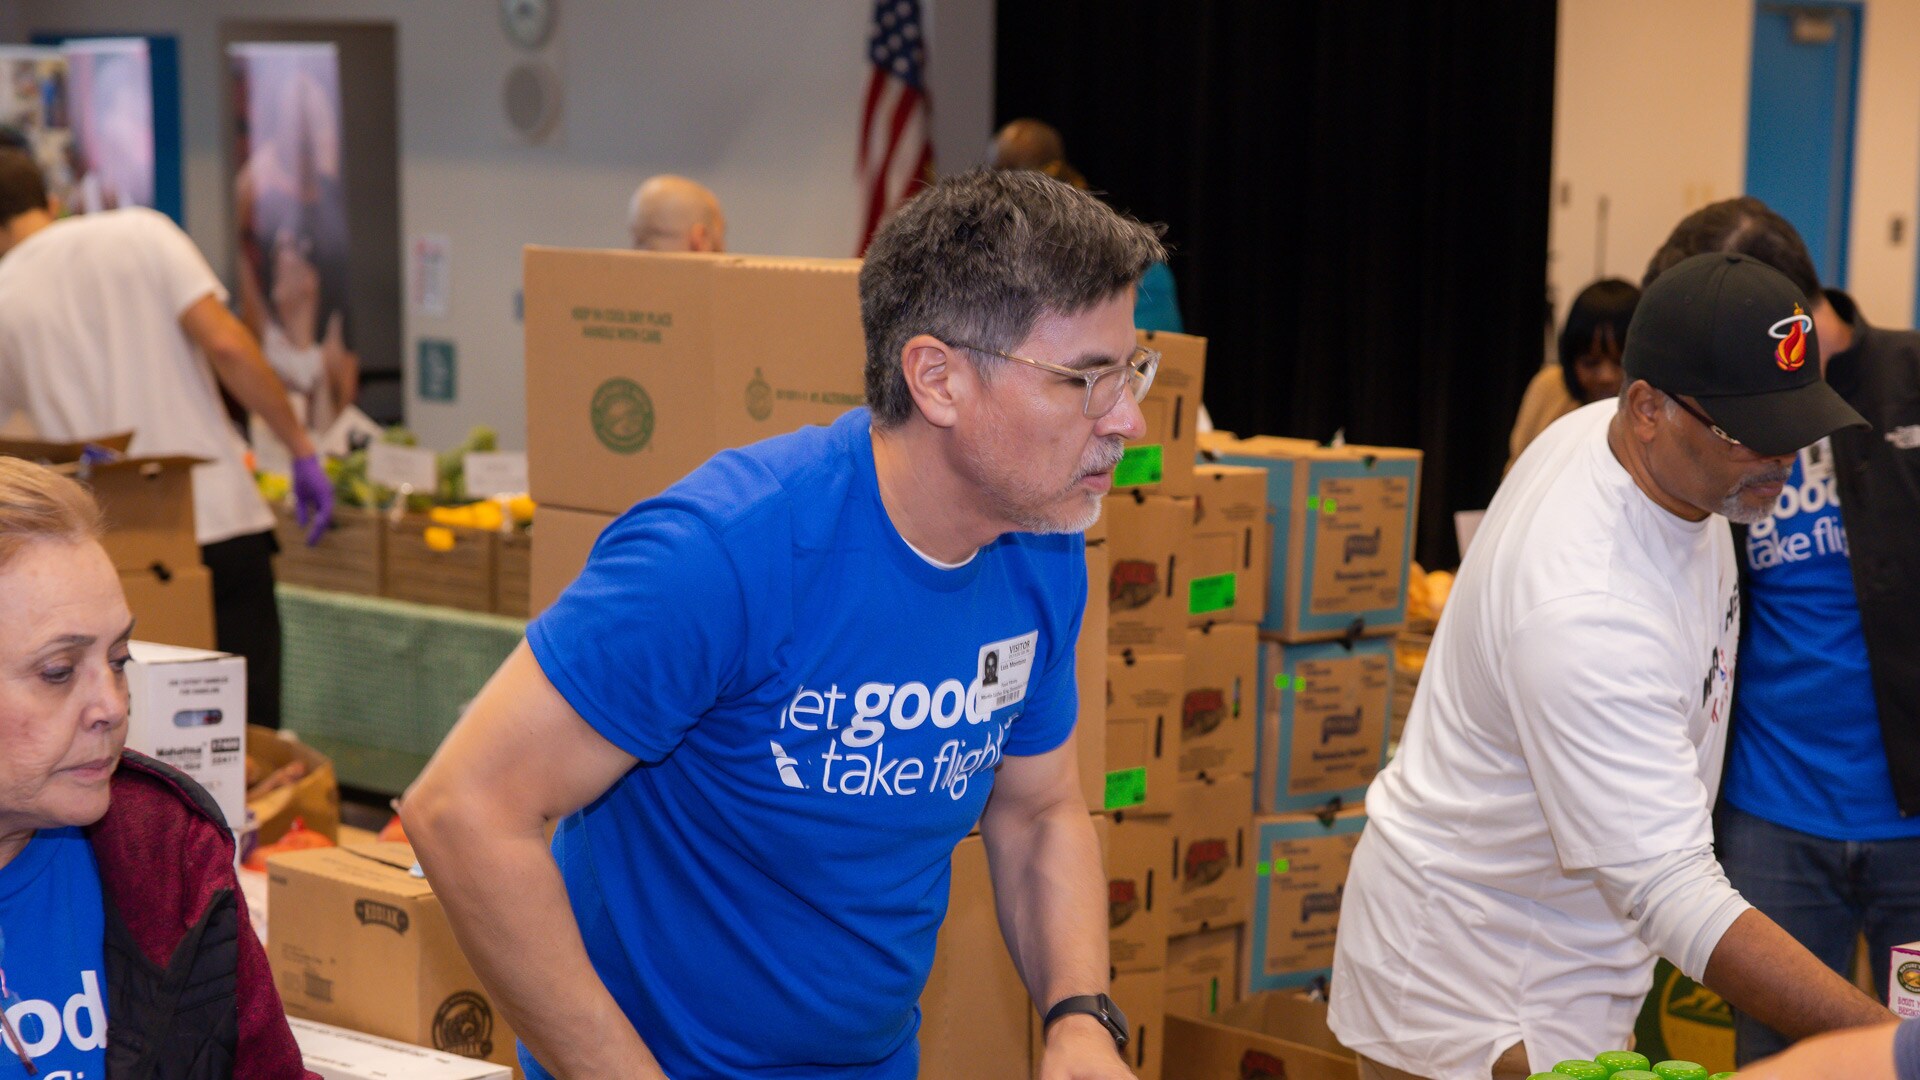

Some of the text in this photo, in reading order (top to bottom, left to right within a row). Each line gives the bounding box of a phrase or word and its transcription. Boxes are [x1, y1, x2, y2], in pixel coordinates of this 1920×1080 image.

[1747, 516, 1850, 570] take fli
[1009, 640, 1031, 654] VISITOR
[780, 683, 846, 731] let
[822, 738, 924, 796] take
[364, 902, 400, 927] KODIAK
